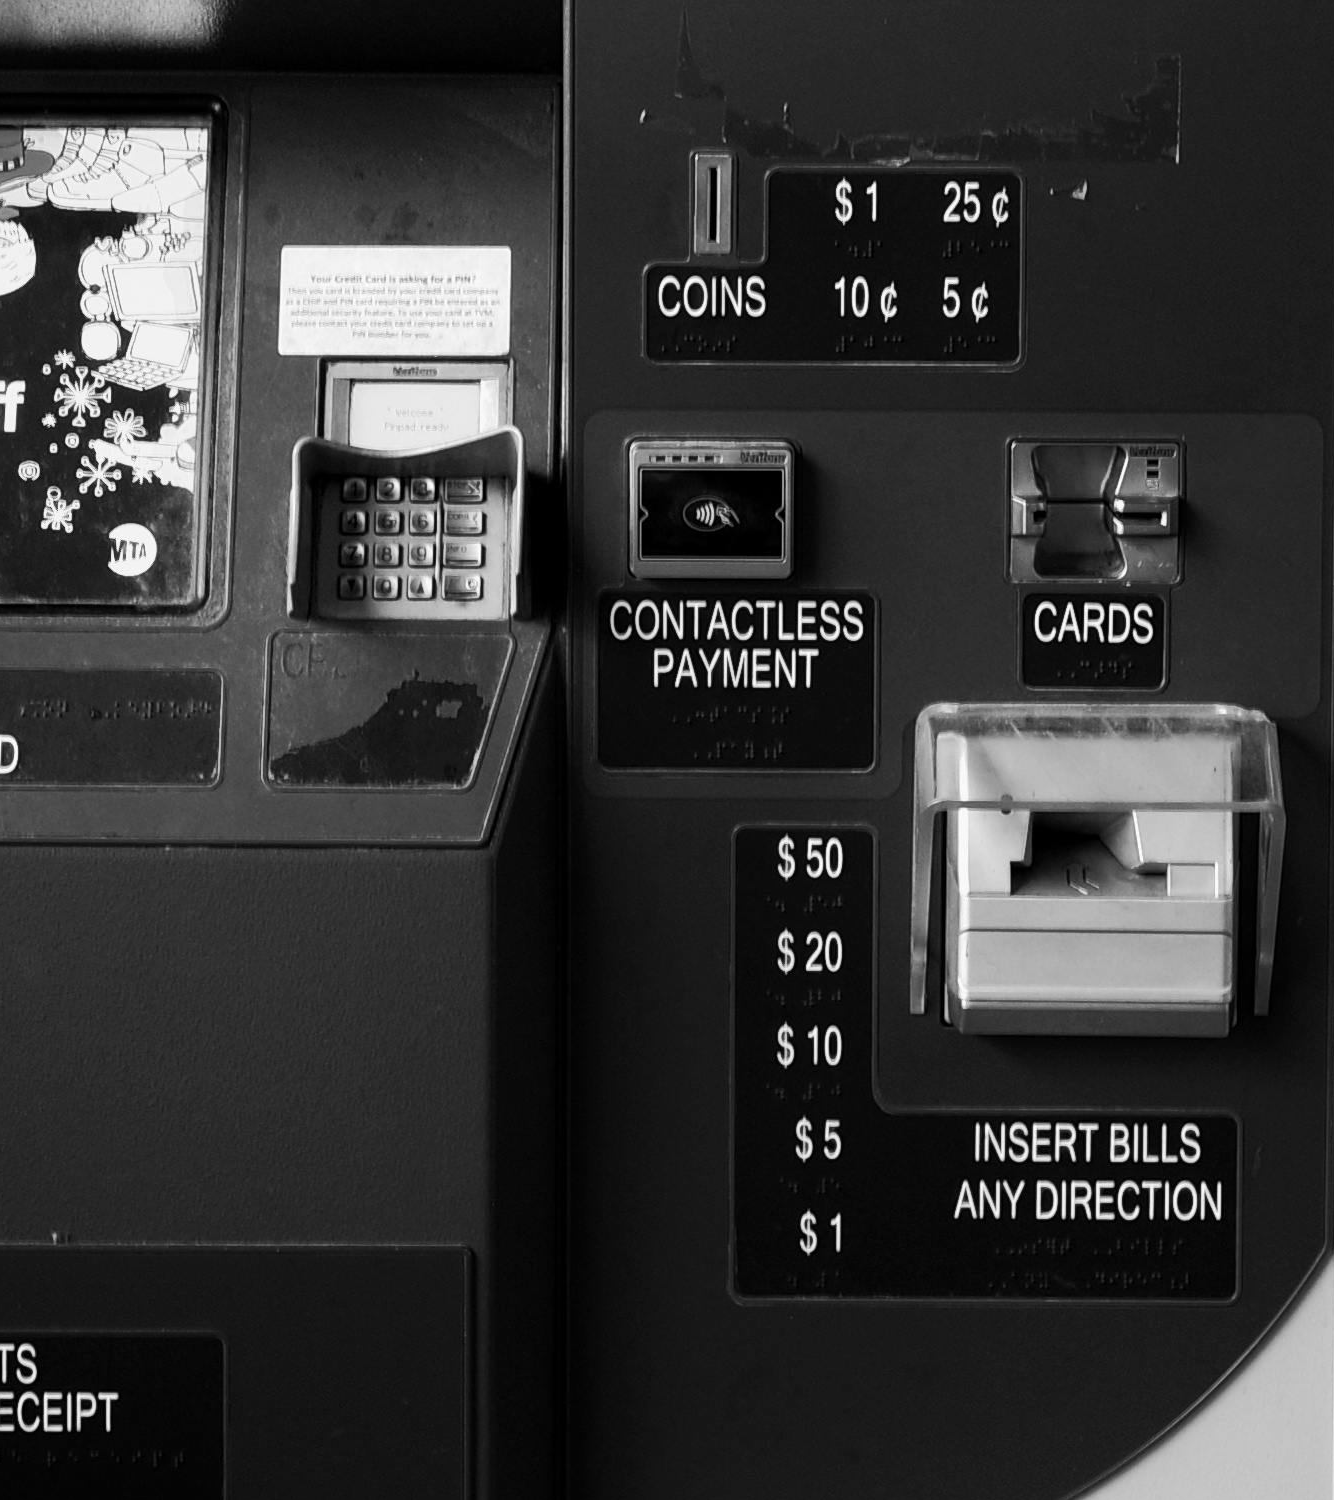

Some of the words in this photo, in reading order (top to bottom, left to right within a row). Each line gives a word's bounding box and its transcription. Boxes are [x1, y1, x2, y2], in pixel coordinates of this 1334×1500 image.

[659, 276, 765, 317] COINS
[109, 538, 146, 561] MTA
[610, 600, 863, 641] CONTACTLESS
[1035, 602, 1153, 644] CARDS
[654, 649, 819, 688] PAYMENT
[975, 1122, 1099, 1162] INSERT
[1110, 1123, 1200, 1163] BILLS
[954, 1180, 1025, 1219] ANY
[1036, 1181, 1221, 1221] DIRECTION
